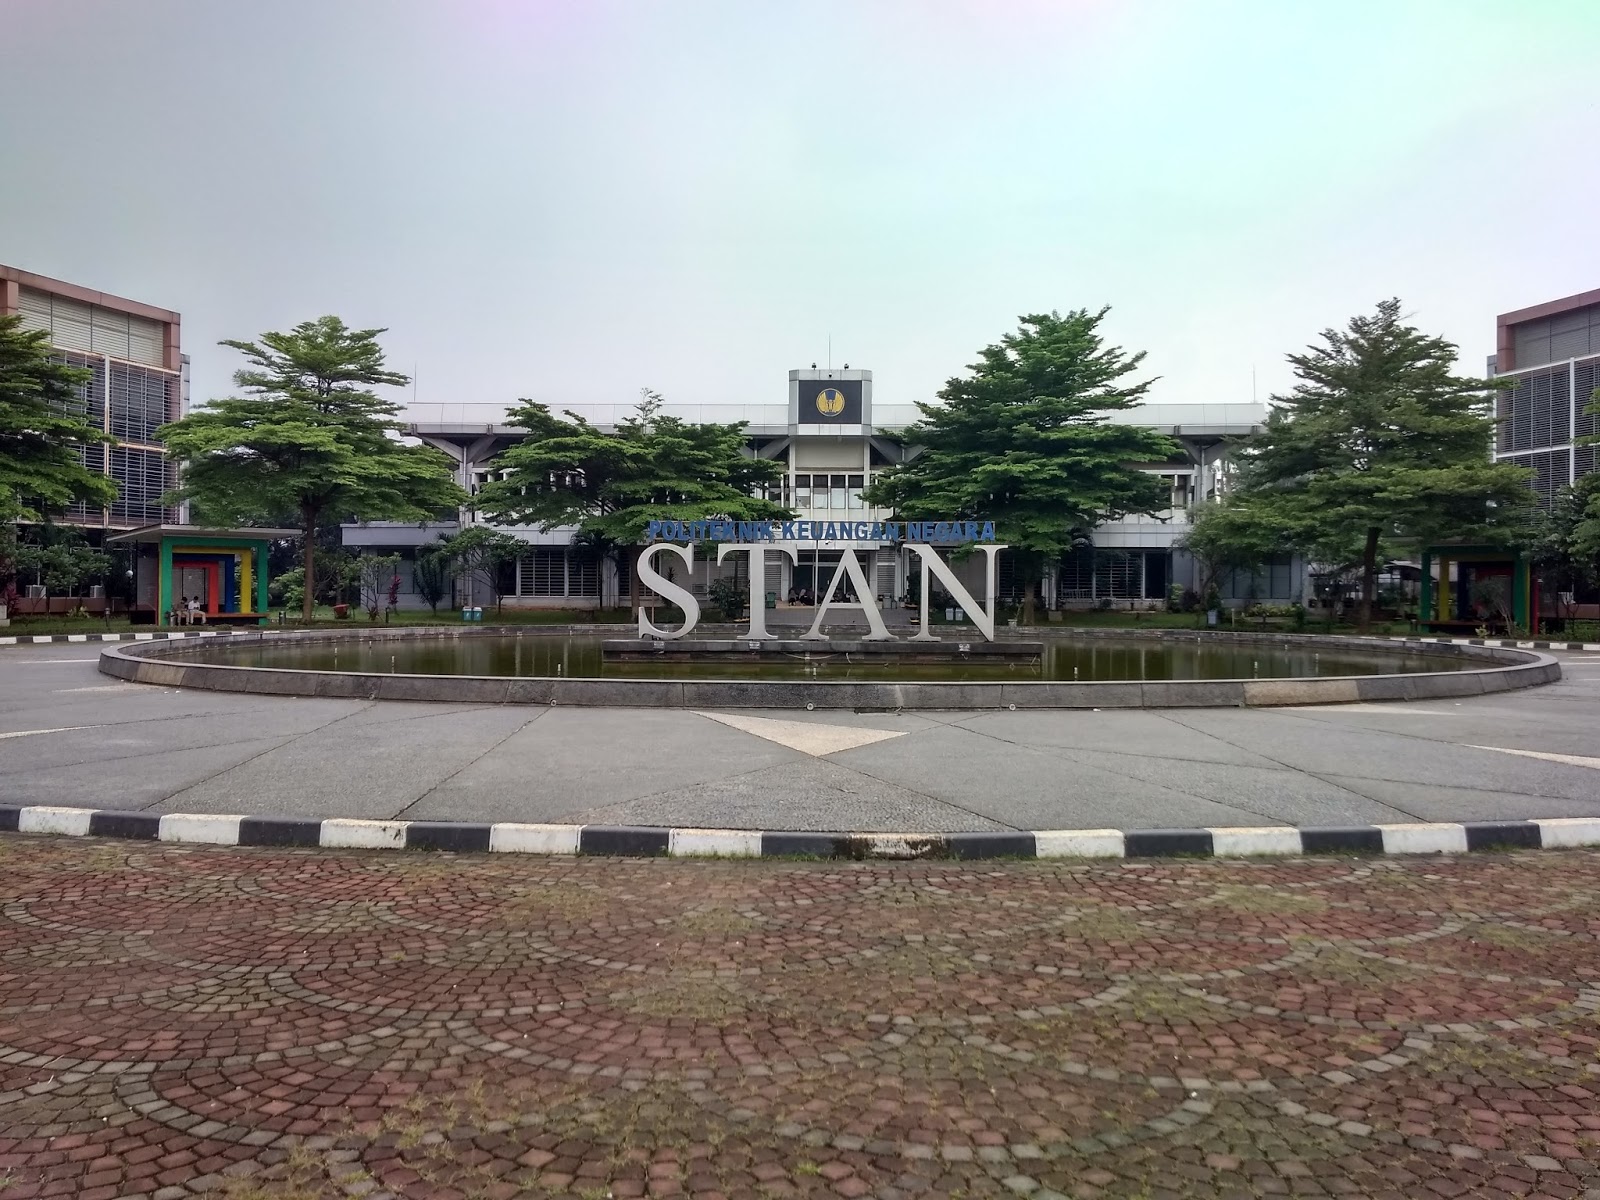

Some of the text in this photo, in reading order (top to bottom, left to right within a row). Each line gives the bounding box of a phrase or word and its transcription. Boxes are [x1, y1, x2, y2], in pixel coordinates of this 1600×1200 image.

[649, 520, 995, 541] POLITEKNIK KEUANGAN NEGARA
[636, 543, 1008, 642] STAN
